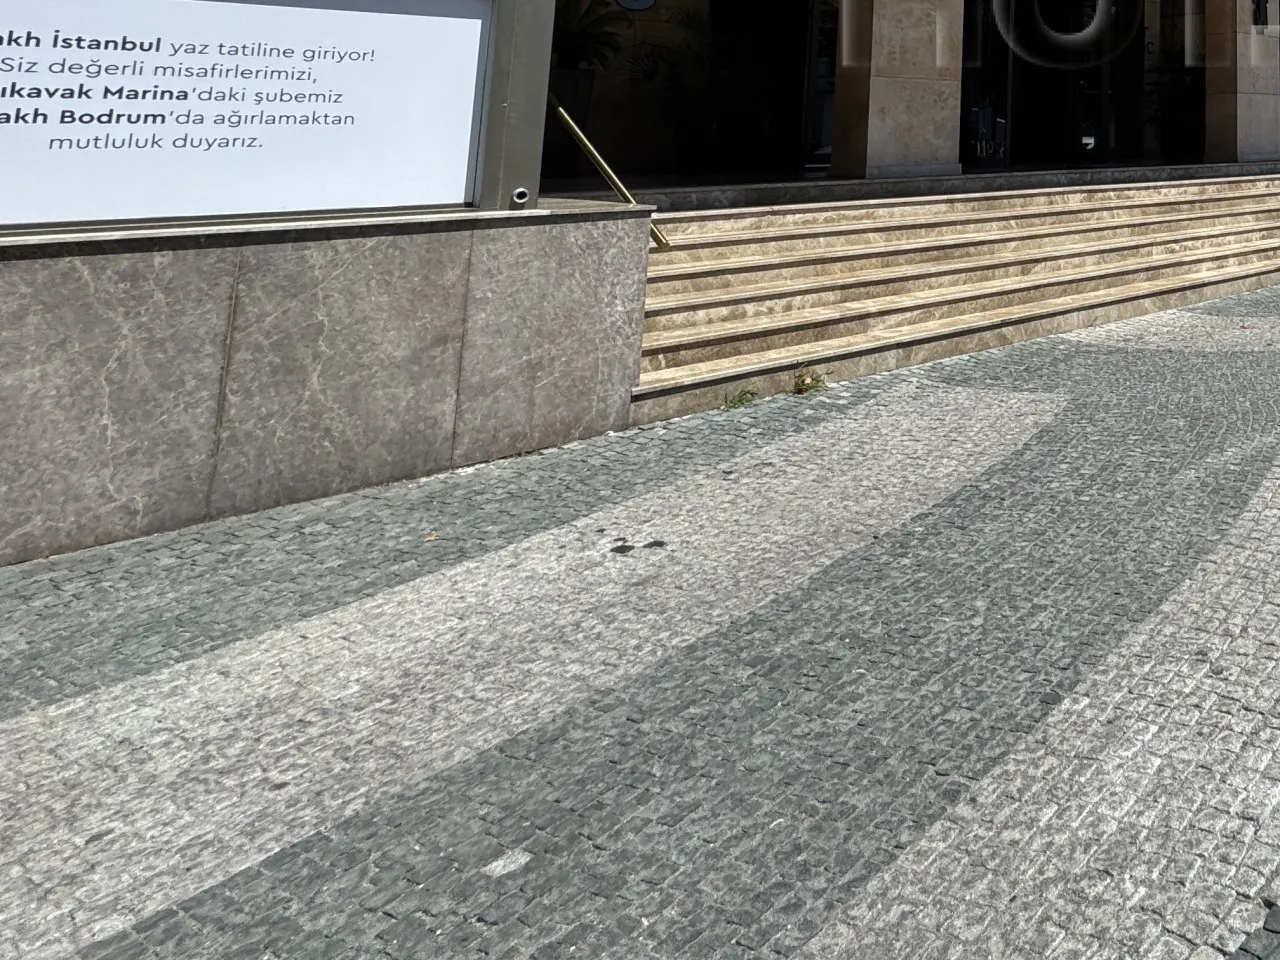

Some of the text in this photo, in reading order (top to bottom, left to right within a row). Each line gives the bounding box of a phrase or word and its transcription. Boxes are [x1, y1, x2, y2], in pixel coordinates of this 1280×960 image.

[52, 29, 162, 53] İstanbul
[168, 42, 211, 57] yaz
[217, 41, 296, 59] tatiline
[302, 46, 376, 64] giriyor!
[0, 56, 318, 85] Siz değerli misafirlerimizi,
[253, 88, 344, 105] şubemiz
[213, 109, 356, 129] ağırlamaktan
[49, 132, 264, 152] mutluluk duyarız.
